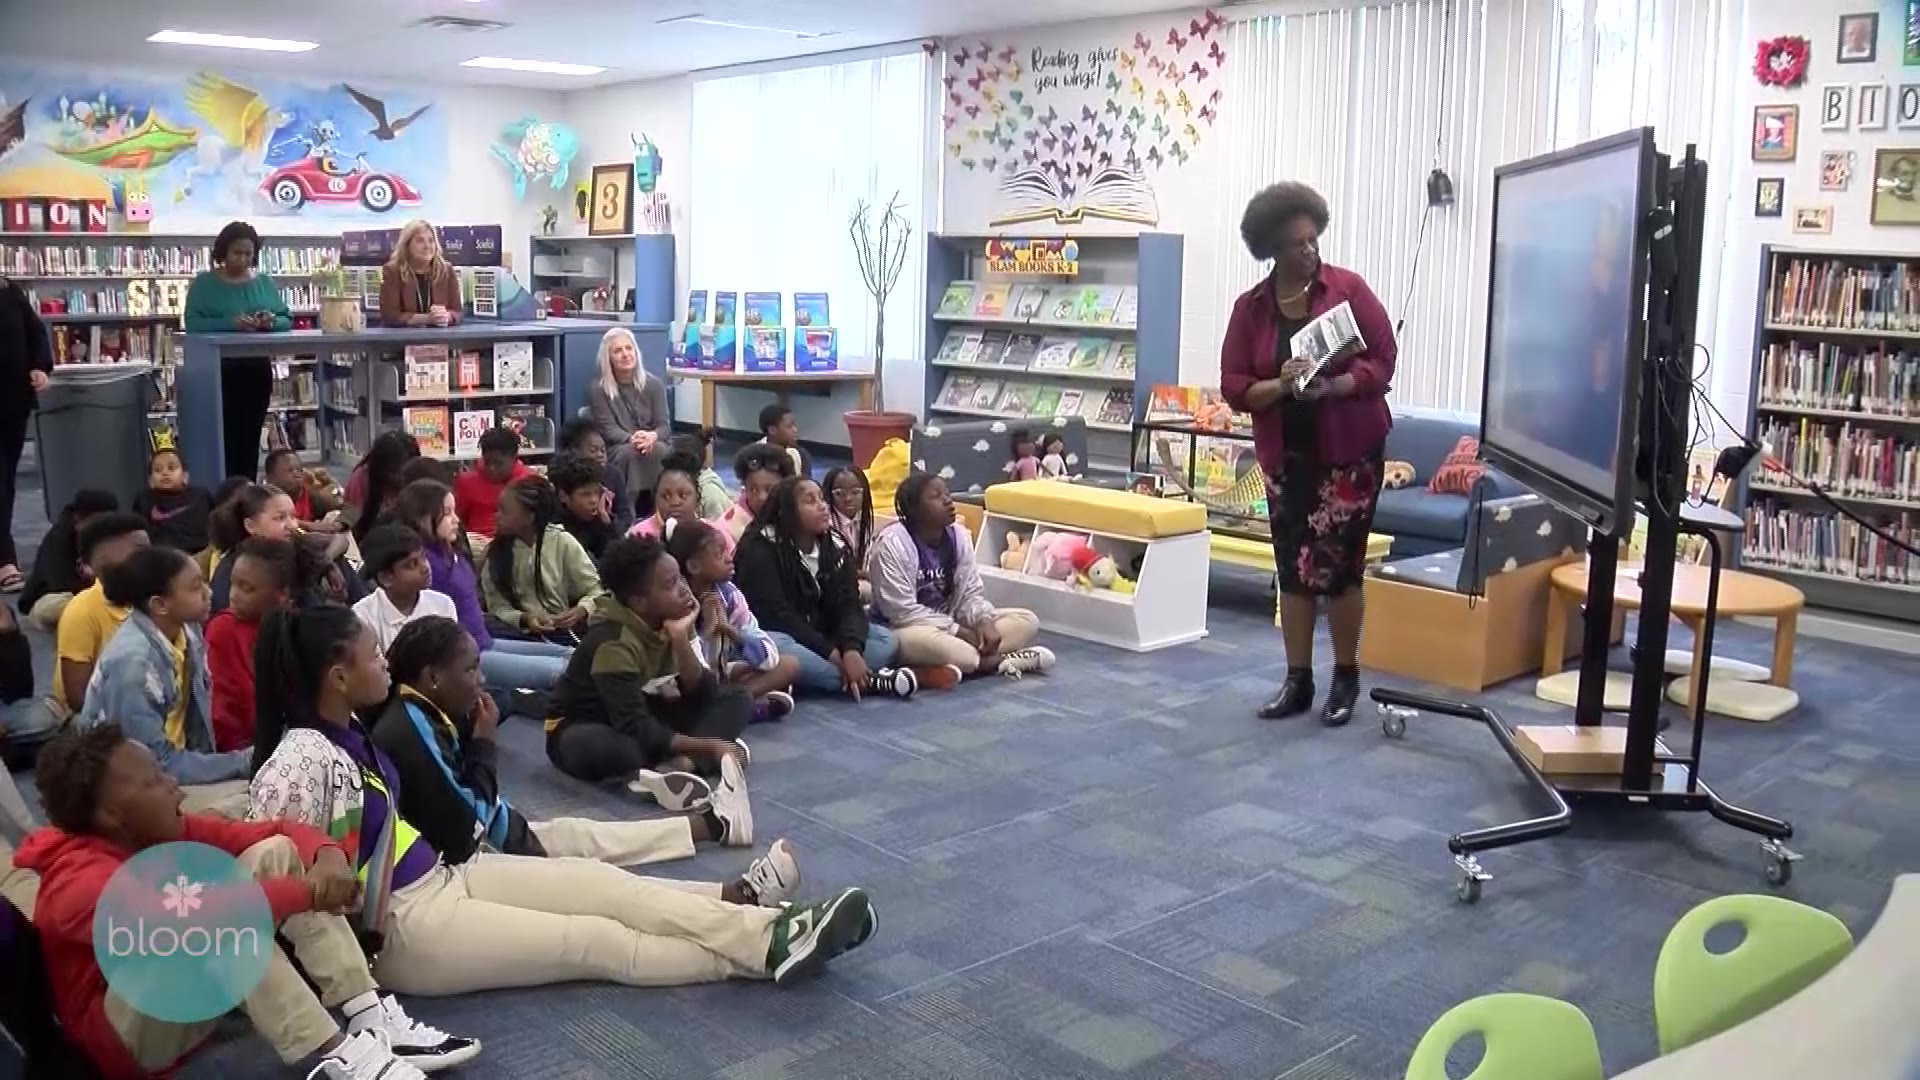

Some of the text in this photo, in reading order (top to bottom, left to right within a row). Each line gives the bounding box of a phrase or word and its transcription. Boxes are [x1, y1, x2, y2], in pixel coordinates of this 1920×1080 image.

[1031, 46, 1118, 73] Reading gives
[1034, 63, 1102, 95] you wings!
[14, 202, 107, 225] ION
[602, 182, 619, 219] 3
[1018, 261, 1054, 271] BOOKS
